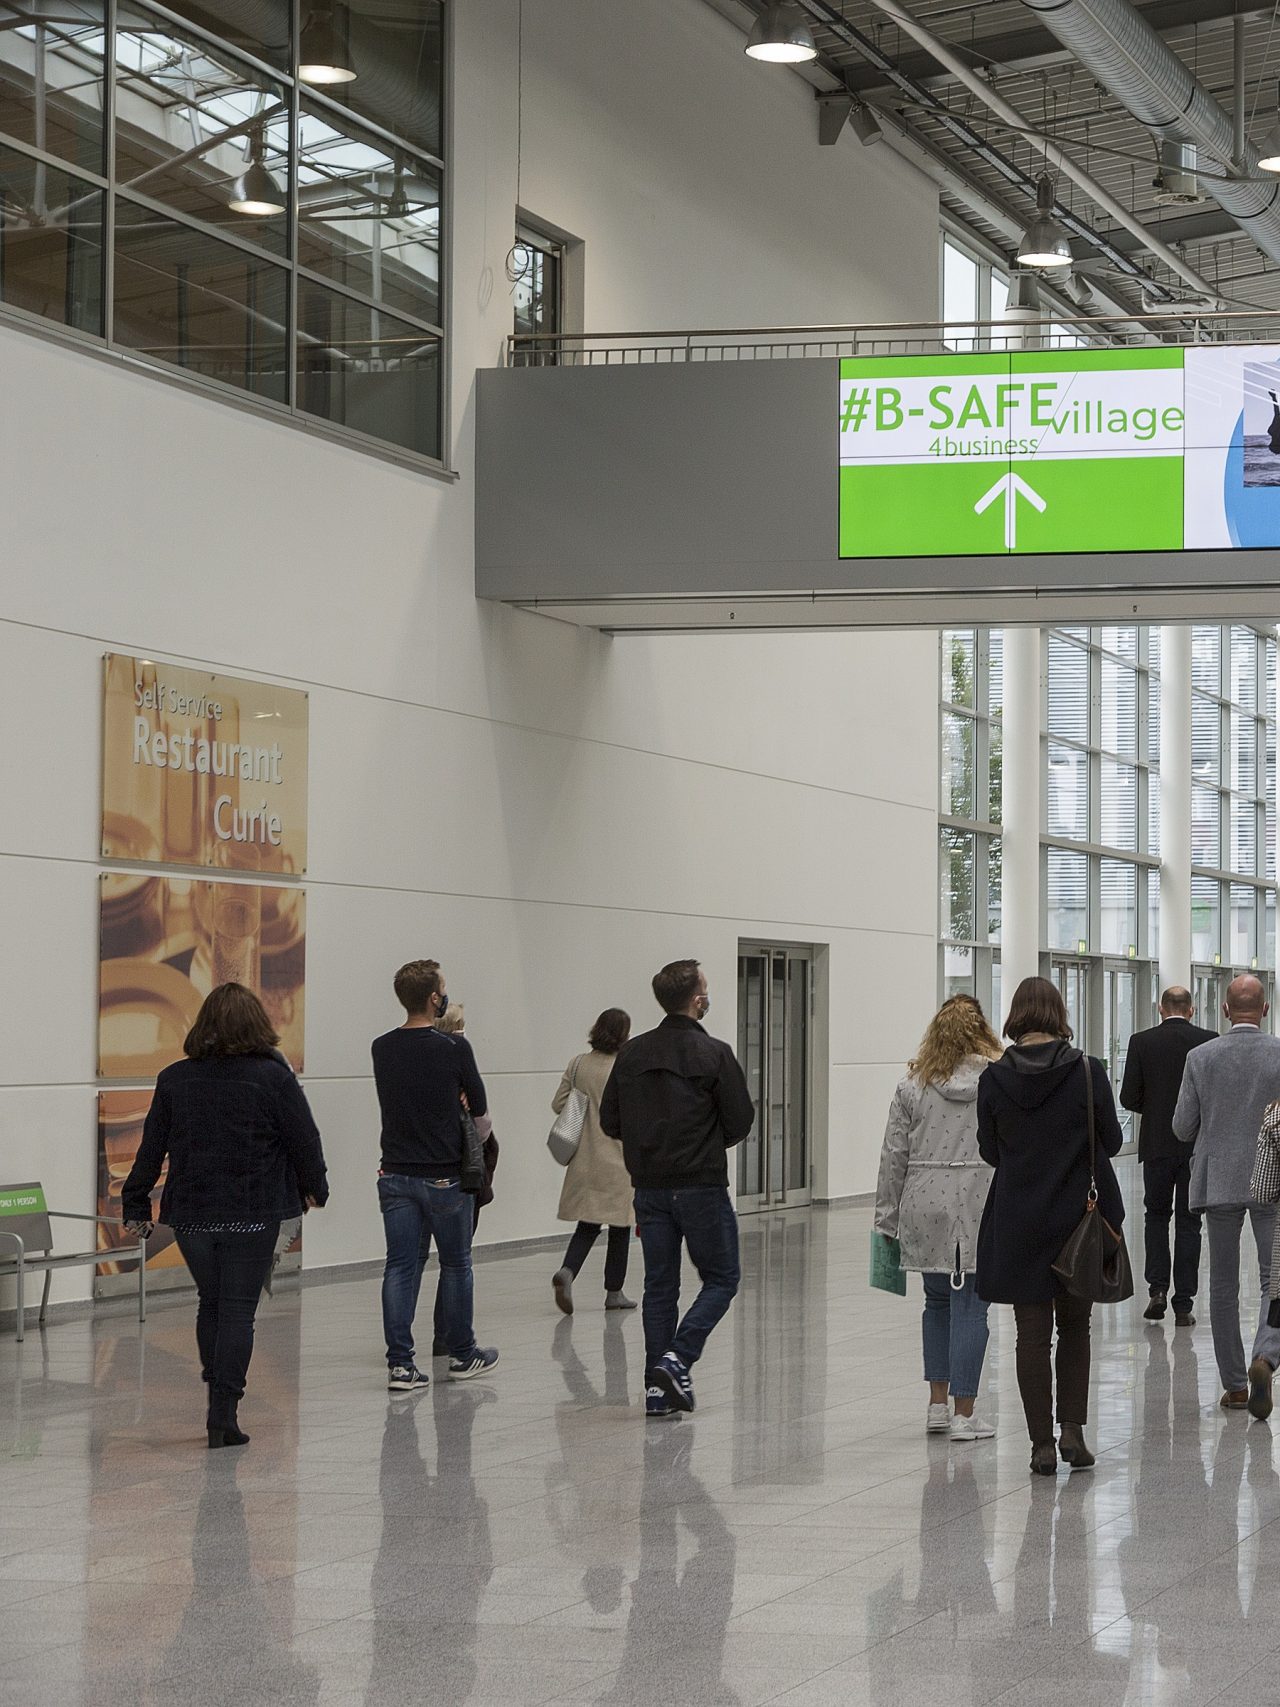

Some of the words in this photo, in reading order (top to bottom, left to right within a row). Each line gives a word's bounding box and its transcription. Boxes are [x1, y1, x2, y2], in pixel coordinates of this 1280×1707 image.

[839, 382, 1058, 432] #B-SAFE
[1051, 400, 1184, 440] village
[928, 436, 1038, 457] 4business
[134, 679, 166, 711] Self
[169, 687, 223, 721] Service
[133, 715, 283, 785] Restaurant
[213, 794, 283, 846] Curie
